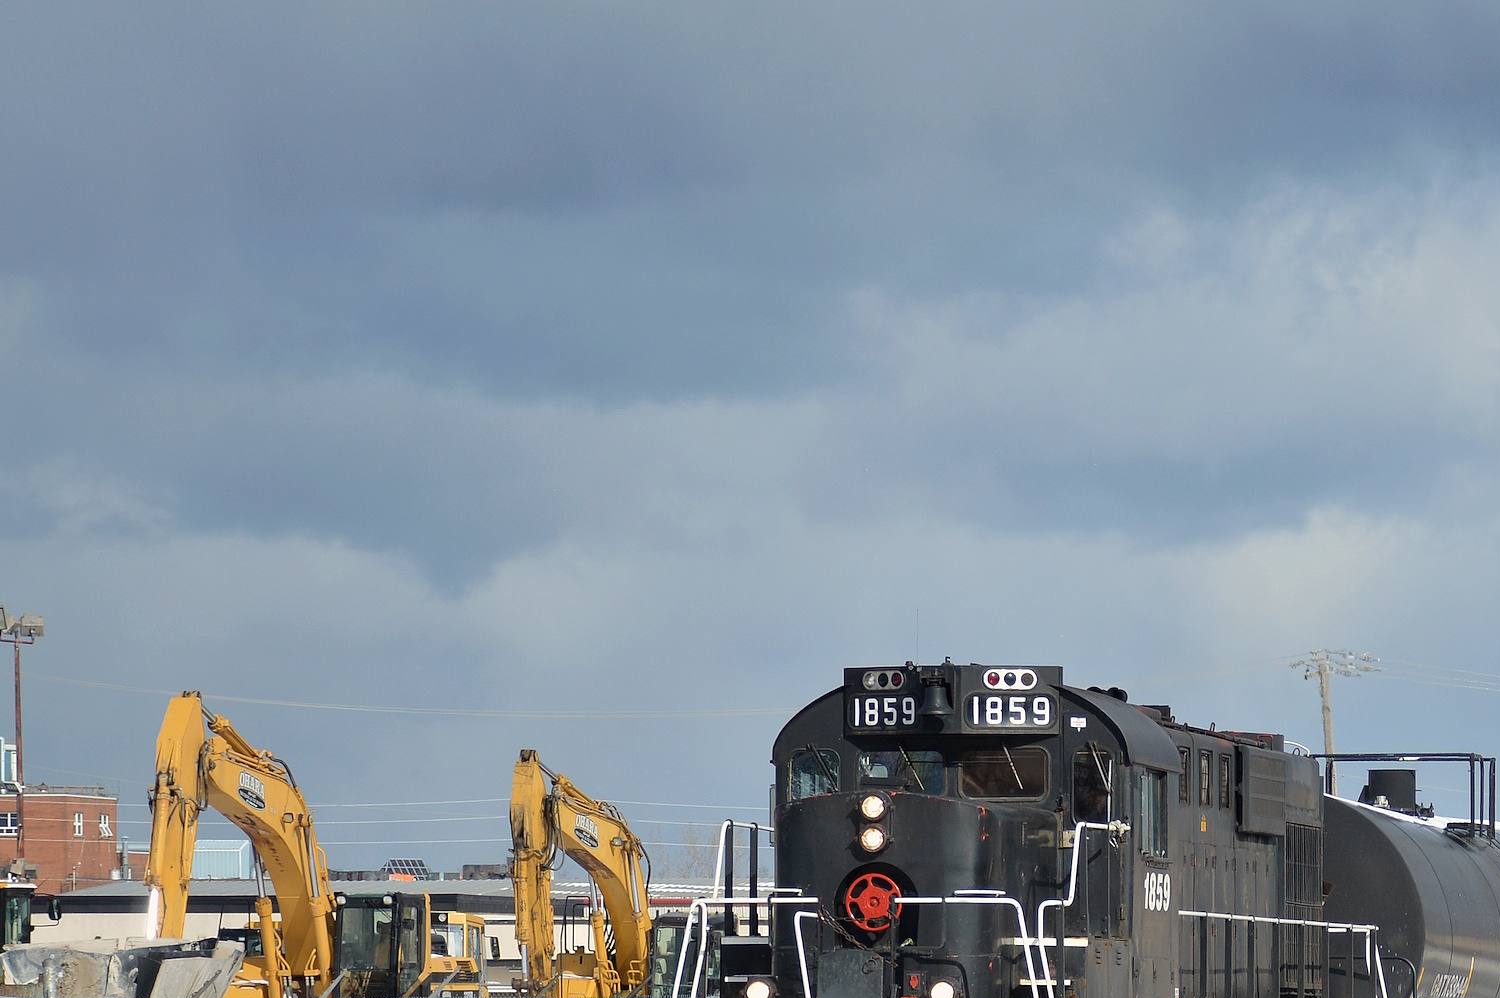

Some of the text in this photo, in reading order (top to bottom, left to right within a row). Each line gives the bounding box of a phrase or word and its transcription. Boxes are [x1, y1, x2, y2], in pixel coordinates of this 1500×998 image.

[854, 697, 916, 726] 1859
[972, 696, 1050, 725] 1859
[1143, 872, 1171, 912] 1859
